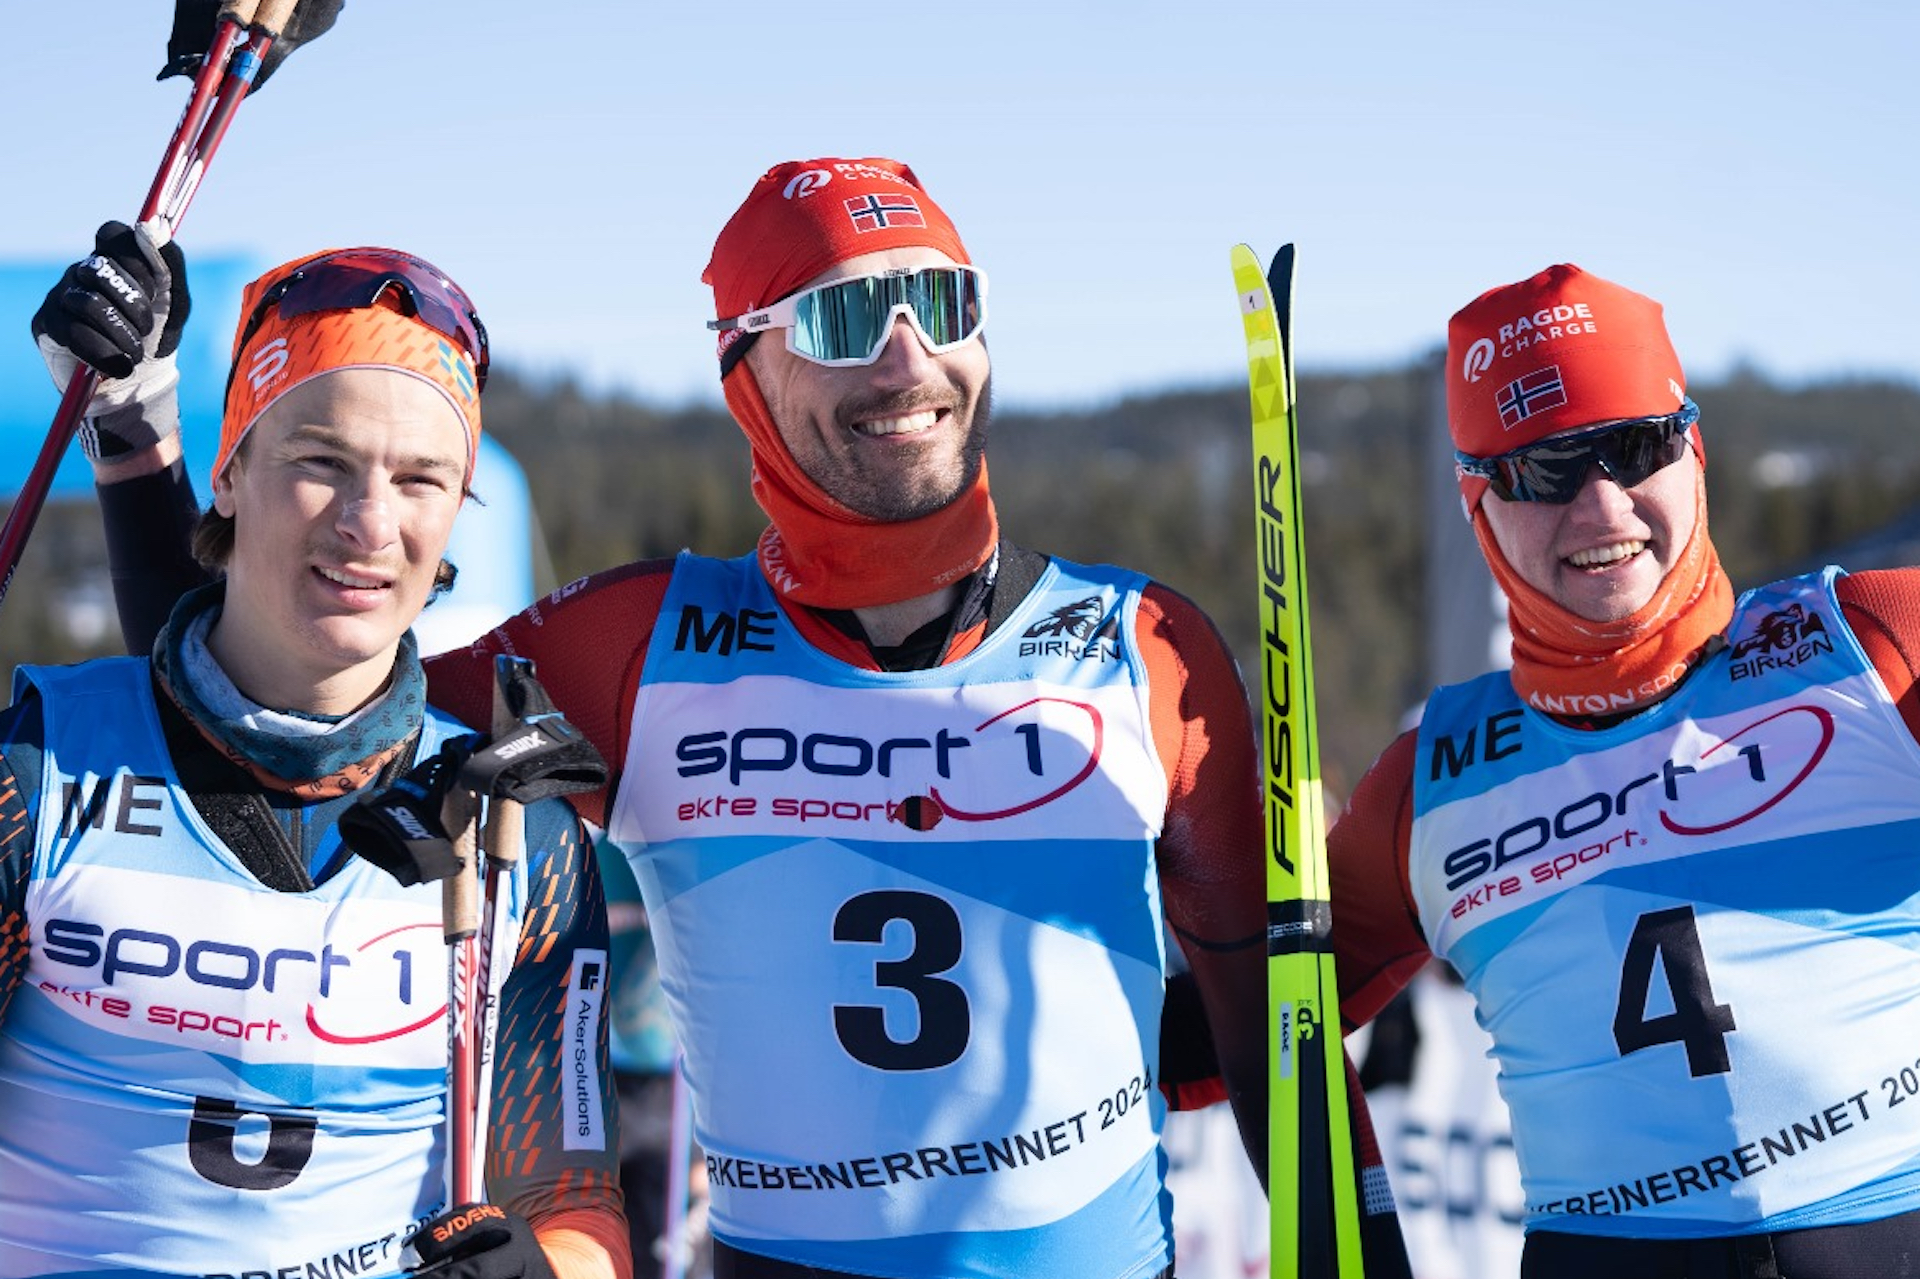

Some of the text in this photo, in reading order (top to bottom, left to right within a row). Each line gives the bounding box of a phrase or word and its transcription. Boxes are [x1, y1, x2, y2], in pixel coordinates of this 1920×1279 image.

[1500, 303, 1593, 343] RAGDE
[1502, 321, 1597, 358] CHARGE
[673, 607, 778, 656] ME
[1019, 641, 1121, 662] BIRKEN
[1259, 455, 1294, 876] FISCHER
[1730, 640, 1834, 682] BIRKEN
[1530, 690, 1635, 713] ANTON
[675, 722, 1044, 786] sport 1
[1431, 709, 1525, 782] ME
[677, 795, 899, 824] ekte sport
[1444, 744, 1766, 891] sport 1
[1451, 828, 1639, 920] ekte sport
[42, 918, 350, 998] sport
[392, 950, 412, 1004] 1
[832, 889, 971, 1071] 3
[1612, 905, 1737, 1080] 4
[147, 1005, 282, 1042] sport
[1098, 1067, 1152, 1131] 2024
[1881, 1057, 1920, 1108] 20
